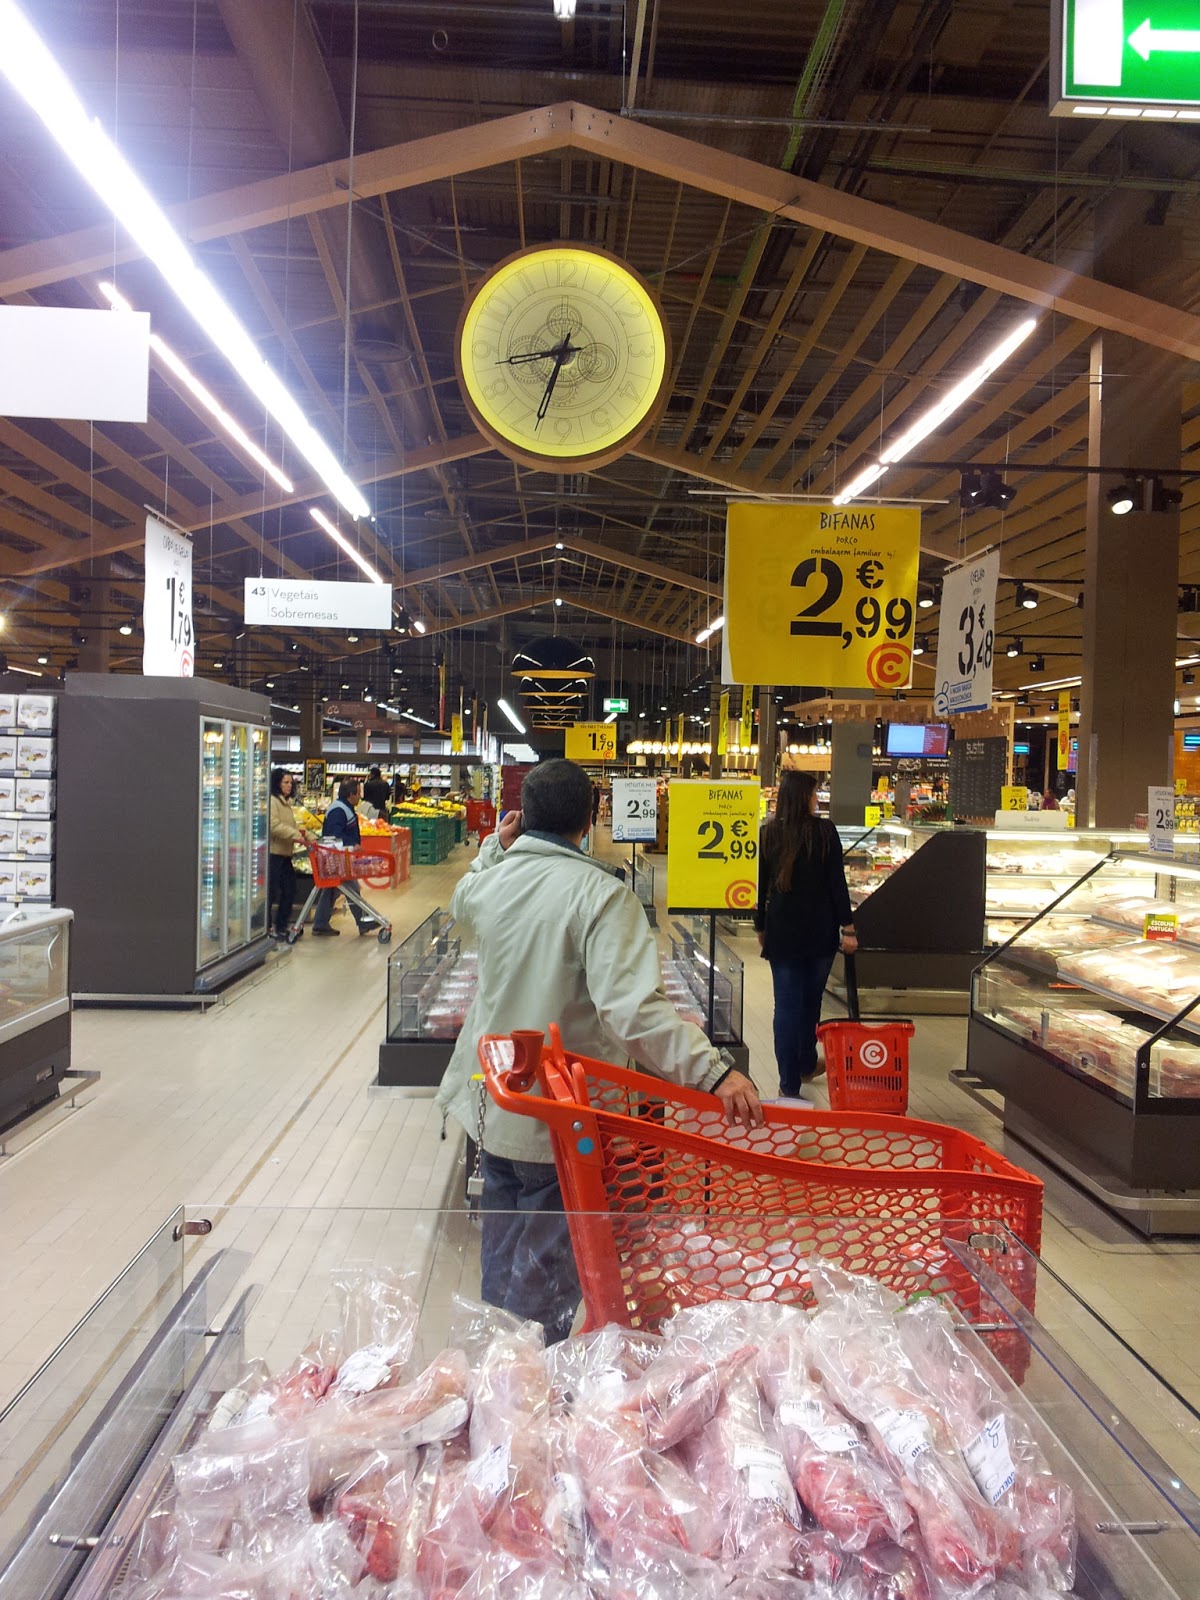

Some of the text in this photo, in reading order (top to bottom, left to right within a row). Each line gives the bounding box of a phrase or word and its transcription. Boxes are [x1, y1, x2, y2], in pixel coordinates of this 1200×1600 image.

[555, 259, 578, 287] 12
[820, 512, 875, 531] BIFANAS
[836, 536, 858, 545] PORCO
[853, 548, 882, 558] familiar
[251, 587, 319, 602] 43 Vegetais
[271, 607, 339, 620] Sobremesas
[708, 789, 743, 801] BIFANAS
